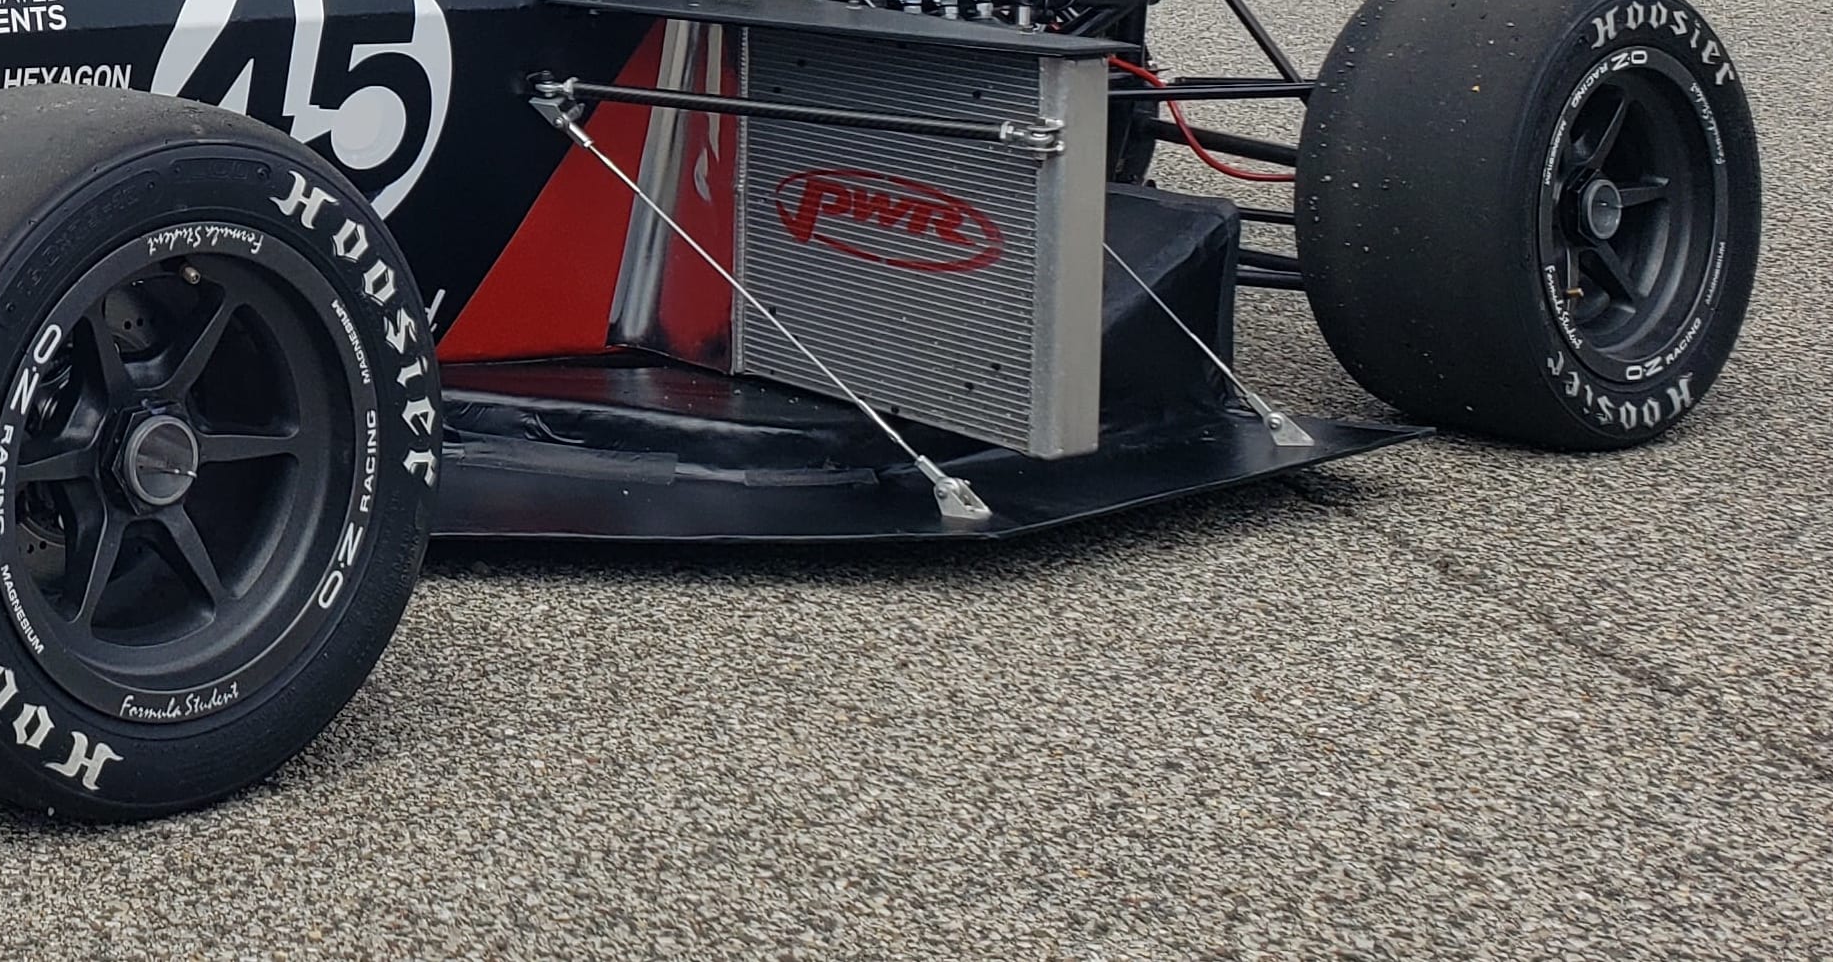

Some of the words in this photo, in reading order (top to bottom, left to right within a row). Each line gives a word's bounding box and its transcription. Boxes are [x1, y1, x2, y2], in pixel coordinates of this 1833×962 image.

[1591, 0, 1736, 86] Hoosier
[4, 64, 132, 91] HEXAGON
[1570, 61, 1610, 109] RACING
[147, 225, 203, 256] Student
[202, 225, 264, 254] Formula
[785, 177, 978, 244] PWR
[269, 169, 441, 489] Hoosier
[329, 299, 372, 386] MAGNESIUM
[1665, 317, 1702, 365] RACING
[1546, 351, 1695, 430] Hoosier
[358, 408, 377, 513] RACING
[0, 563, 45, 656] MAGNESIUM
[119, 693, 181, 720] Formula
[184, 681, 240, 716] Student
